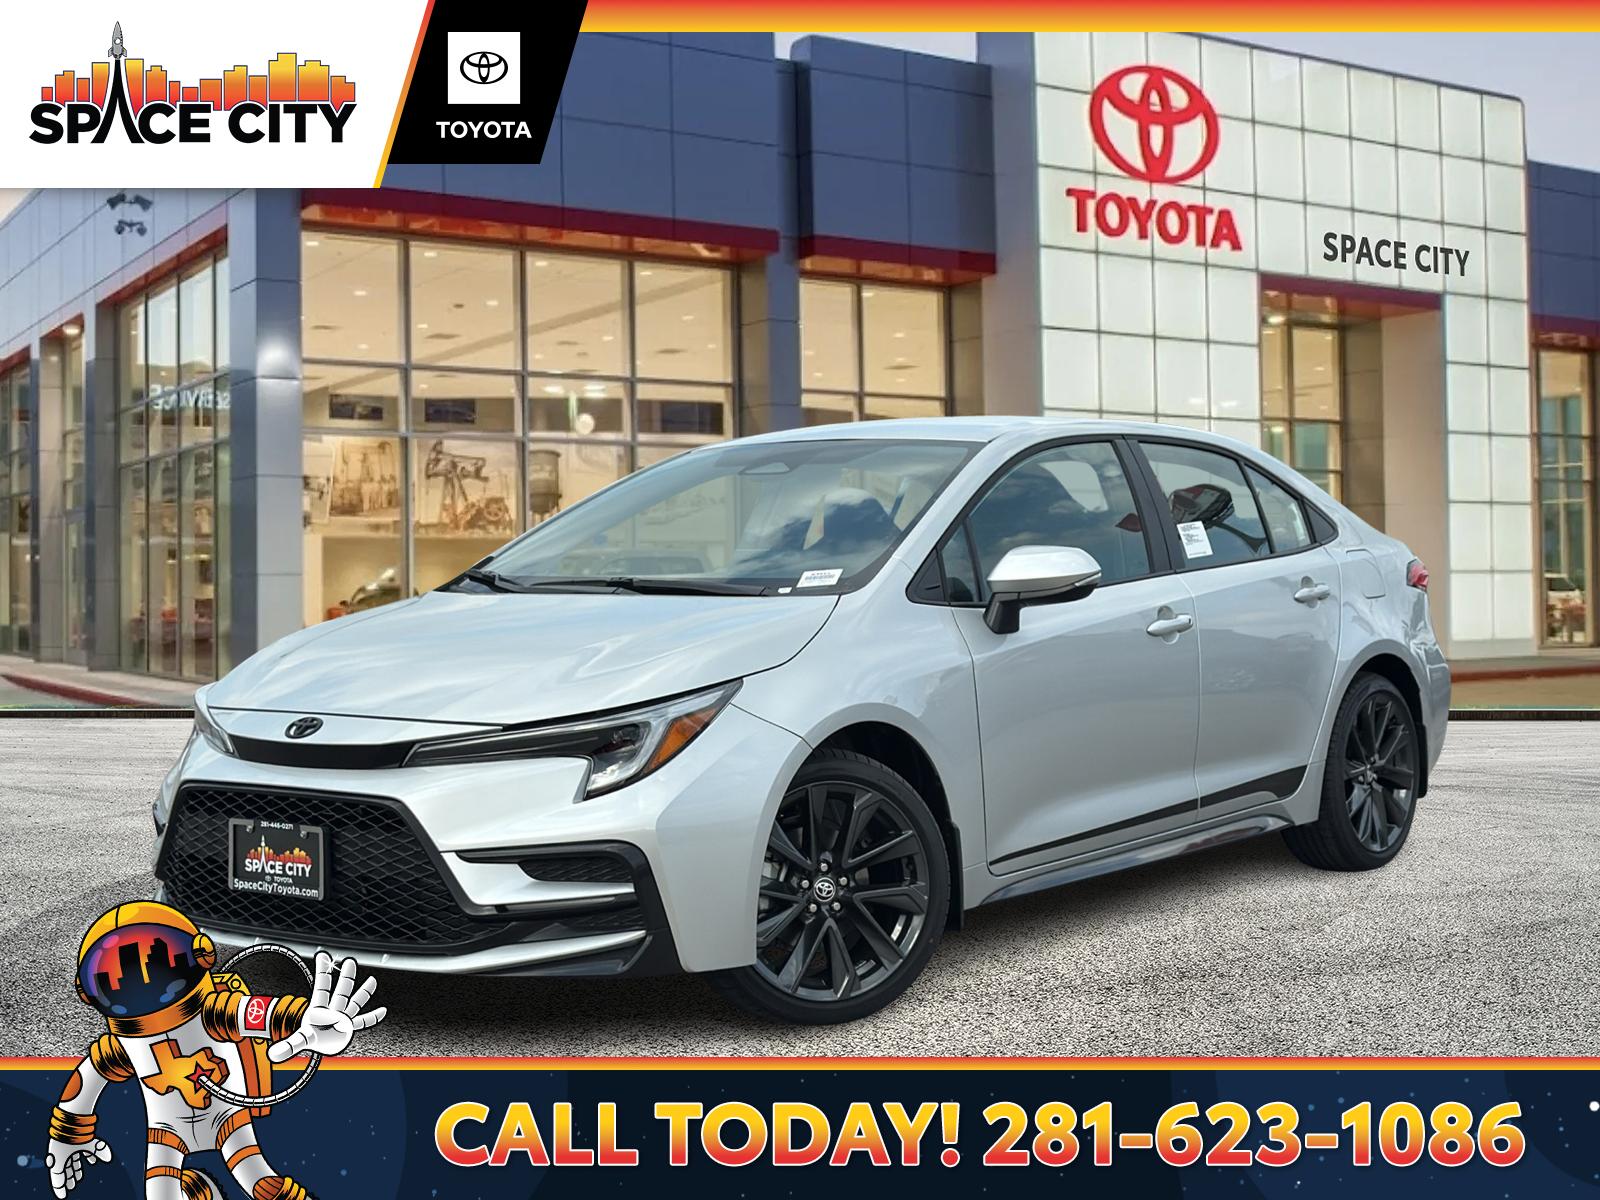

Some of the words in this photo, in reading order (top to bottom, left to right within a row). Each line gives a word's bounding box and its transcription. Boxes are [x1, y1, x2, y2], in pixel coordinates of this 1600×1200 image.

[1066, 187, 1243, 252] TOYOTA
[1322, 232, 1407, 270] SPACE
[1414, 245, 1471, 277] CITY
[244, 856, 283, 874] SPACE
[285, 862, 312, 878] CITY
[234, 879, 318, 897] SpaceCityToyota.com
[273, 876, 293, 884] TOYOTA
